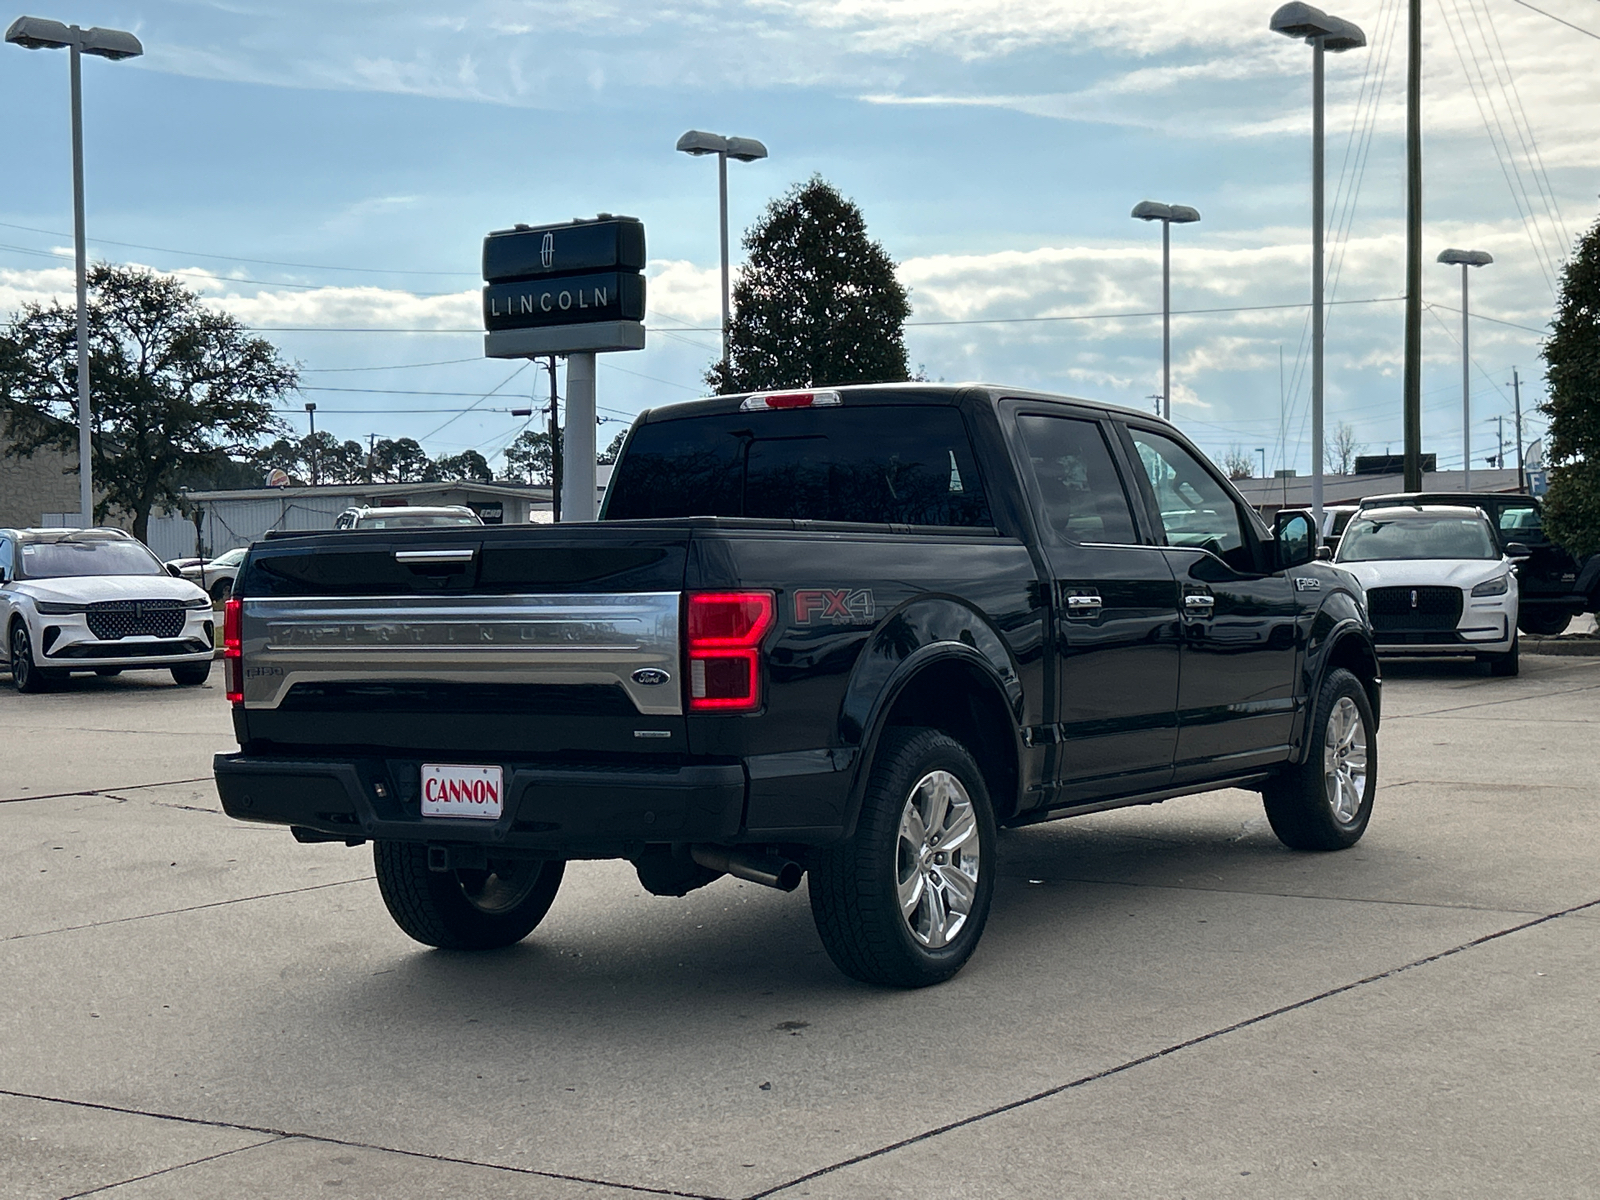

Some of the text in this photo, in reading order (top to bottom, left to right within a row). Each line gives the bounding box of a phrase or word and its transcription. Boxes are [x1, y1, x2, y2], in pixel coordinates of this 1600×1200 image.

[491, 286, 608, 317] LINCOLN
[793, 588, 876, 625] FX4
[638, 671, 661, 684] Ford
[425, 777, 499, 805] CANNON
